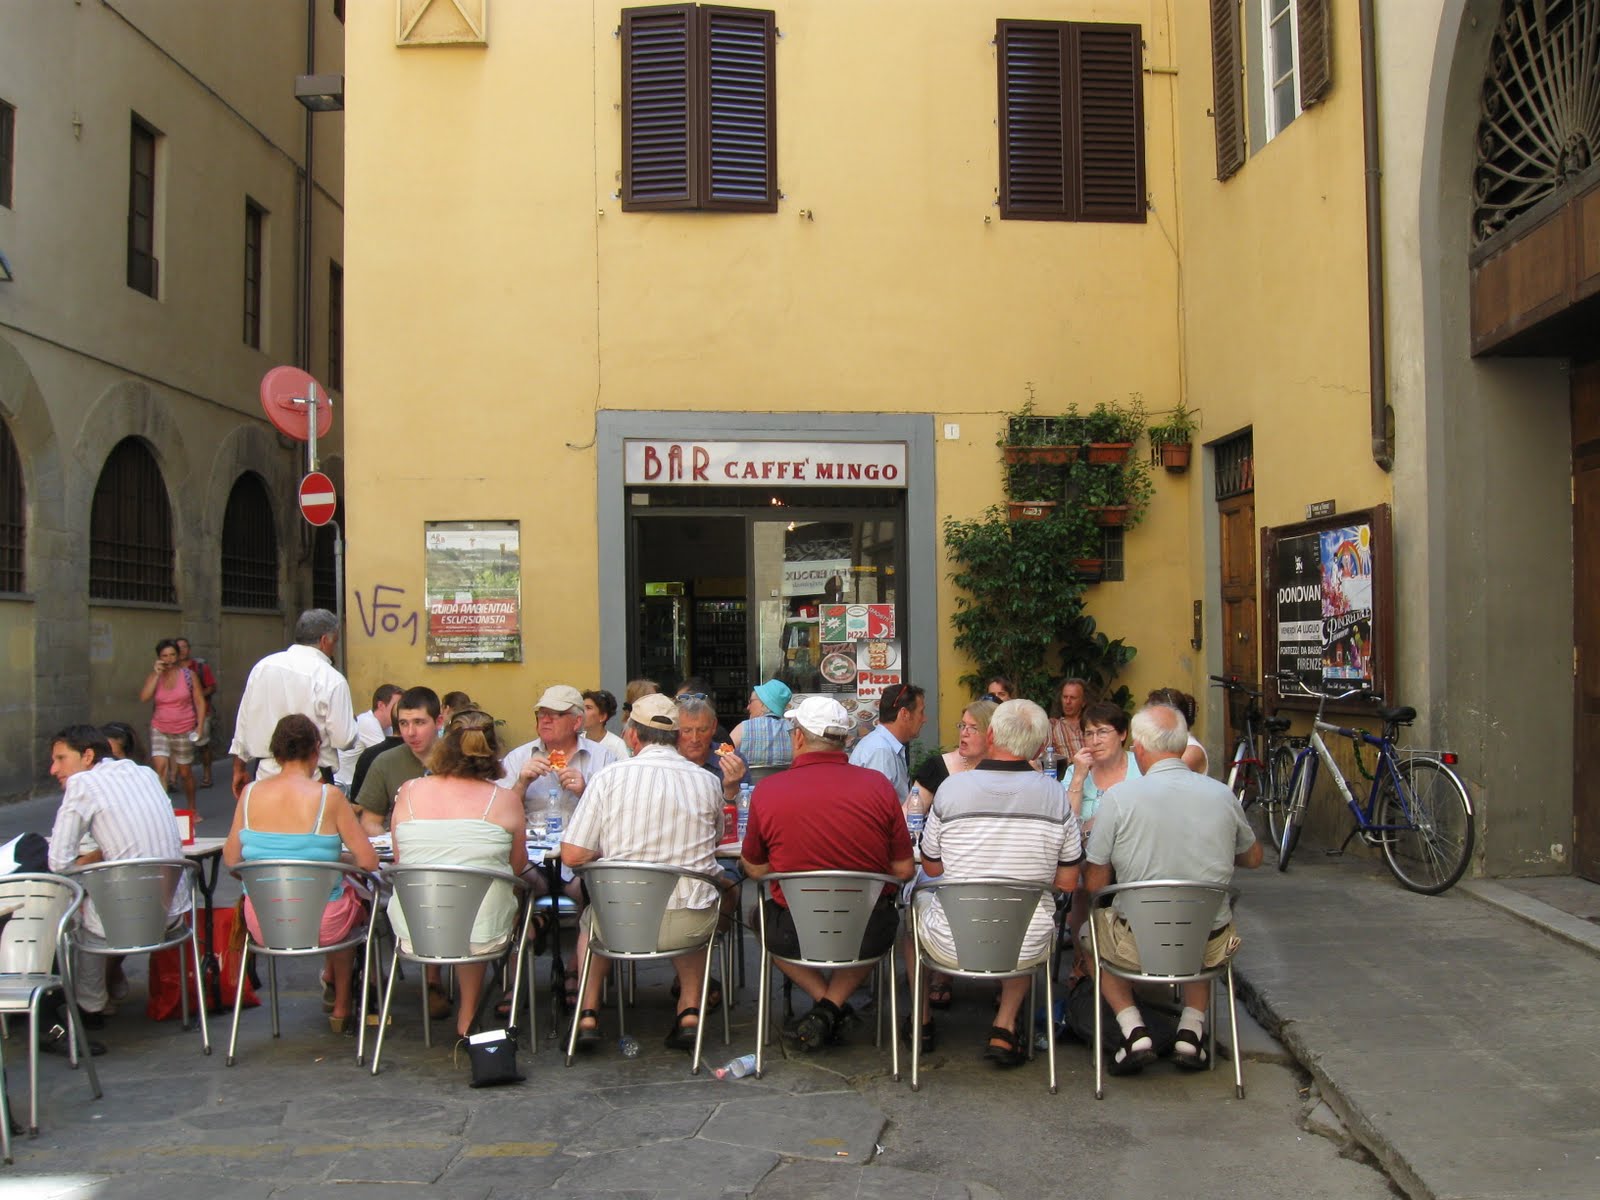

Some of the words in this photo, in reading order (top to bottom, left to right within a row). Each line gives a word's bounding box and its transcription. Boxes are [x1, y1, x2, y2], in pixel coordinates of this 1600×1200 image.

[644, 444, 710, 482] BAR
[816, 463, 898, 481] MINGO
[1279, 584, 1321, 604] DONOVAN
[431, 603, 459, 614] GUIDA
[460, 602, 515, 614] AMBIENTALE
[441, 615, 506, 624] ESCURSIONISTA
[848, 631, 868, 640] PIZZA
[1300, 646, 1307, 655] DA
[1307, 645, 1322, 655] BASSO
[1297, 657, 1322, 670] FIRENZE
[858, 671, 900, 685] Pizza
[858, 686, 876, 697] per
